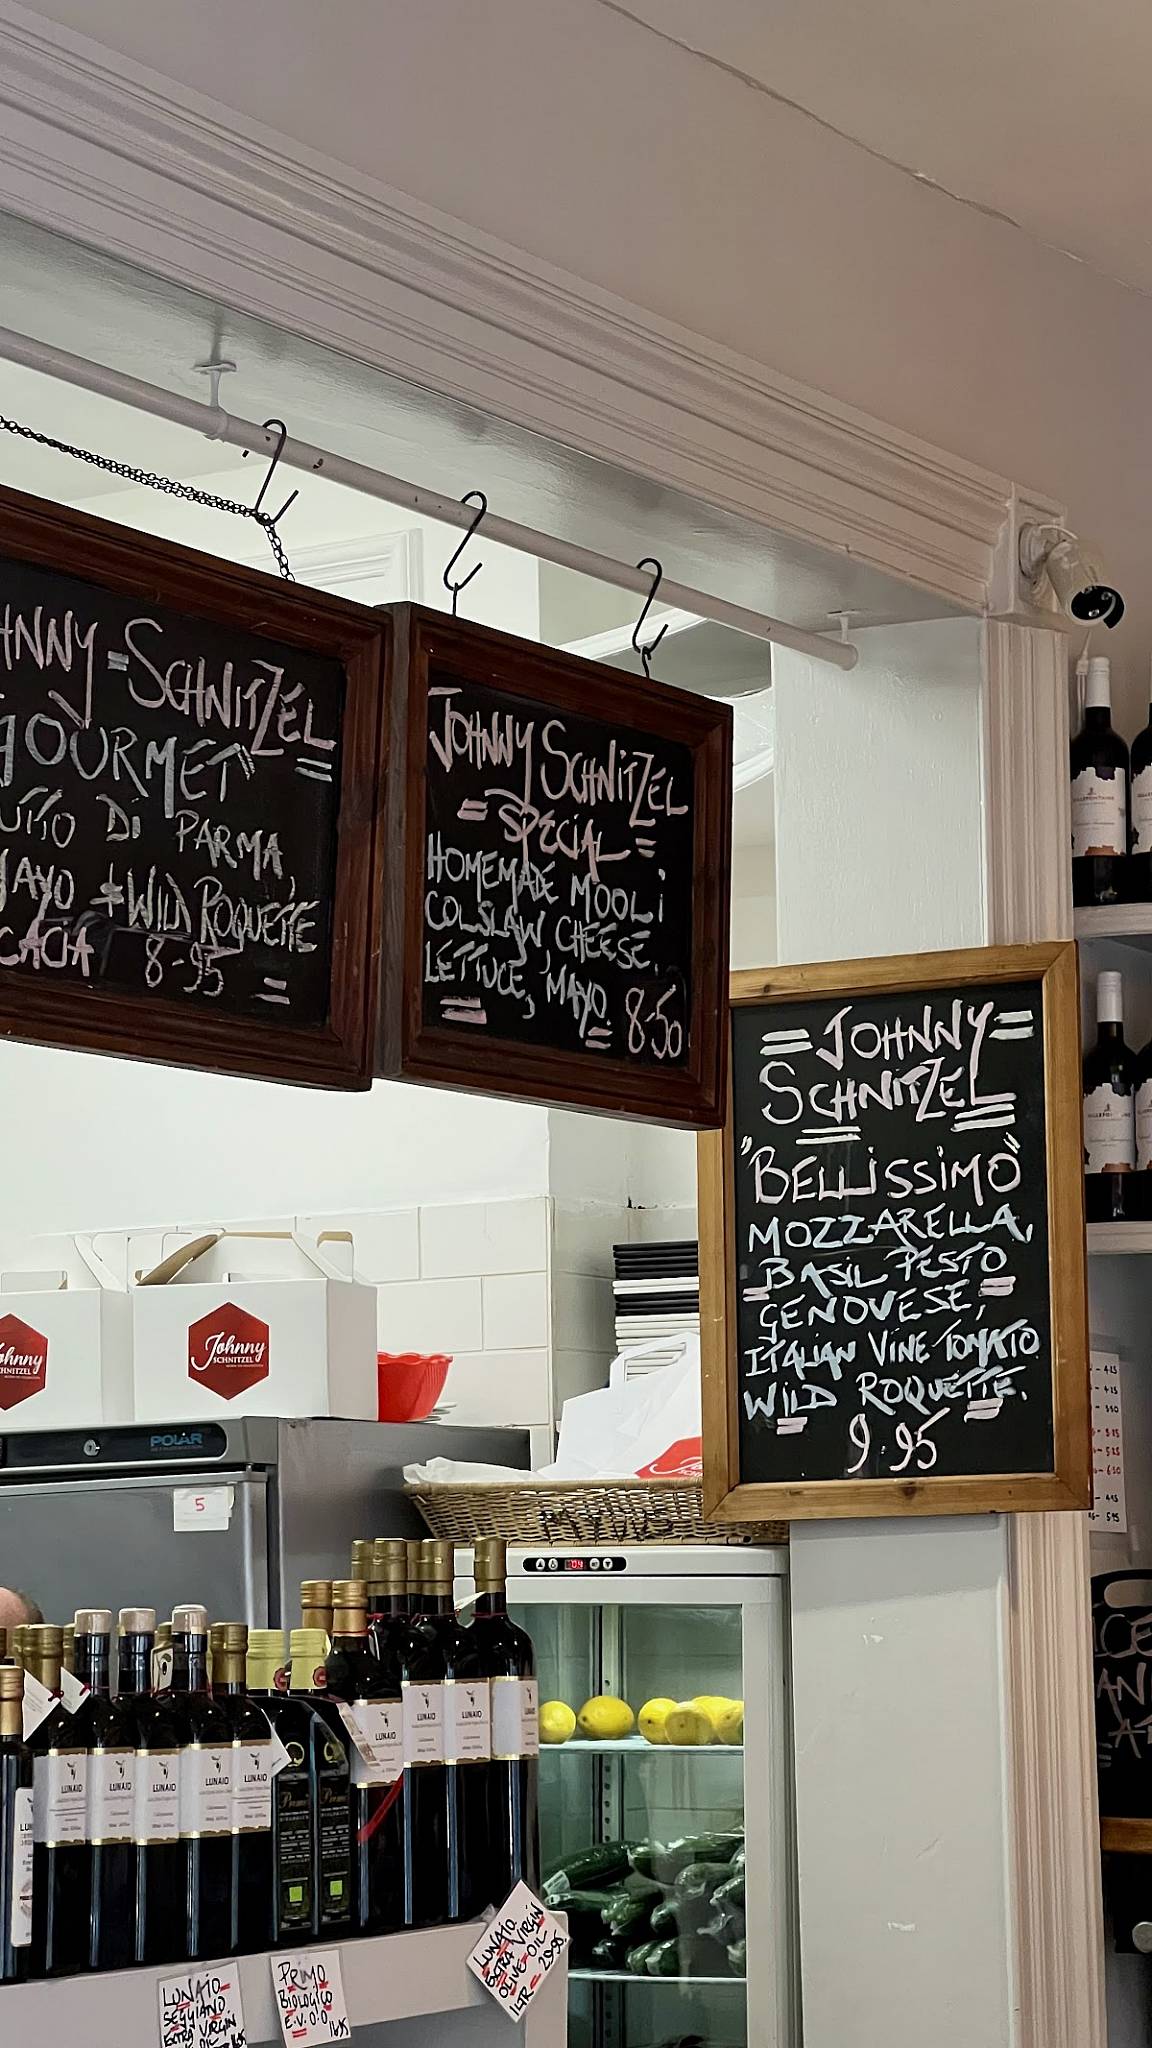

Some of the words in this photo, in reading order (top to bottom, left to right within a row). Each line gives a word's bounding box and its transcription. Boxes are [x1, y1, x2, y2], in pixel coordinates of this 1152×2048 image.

[427, 687, 535, 815] JOHNNY
[540, 719, 689, 828] SCHNITZEL
[174, 809, 283, 880] PARMA
[427, 831, 559, 915] HOMEMADE
[816, 998, 994, 1080] JOHNNY
[758, 1056, 1017, 1125] SCHNITZEL
[758, 1256, 889, 1299] BASIL
[883, 1241, 1008, 1282] PESTO
[190, 1331, 267, 1371] Johnny
[212, 1356, 254, 1364] SCHNITZEL
[743, 1382, 838, 1420] WILD
[150, 1432, 203, 1447] POLAR
[194, 1496, 206, 1512] 5
[416, 1712, 436, 1721] LUNAIO
[462, 1710, 483, 1720] LUNAIO
[375, 1732, 397, 1741] LUNAIO
[205, 1776, 229, 1786] LUNAIO
[244, 1773, 268, 1783] LUNAIO
[60, 1784, 83, 1794] LUNAIO
[109, 1782, 132, 1791] LUNAIO
[152, 1783, 177, 1792] LUNAIO
[526, 1930, 548, 1957] OIL
